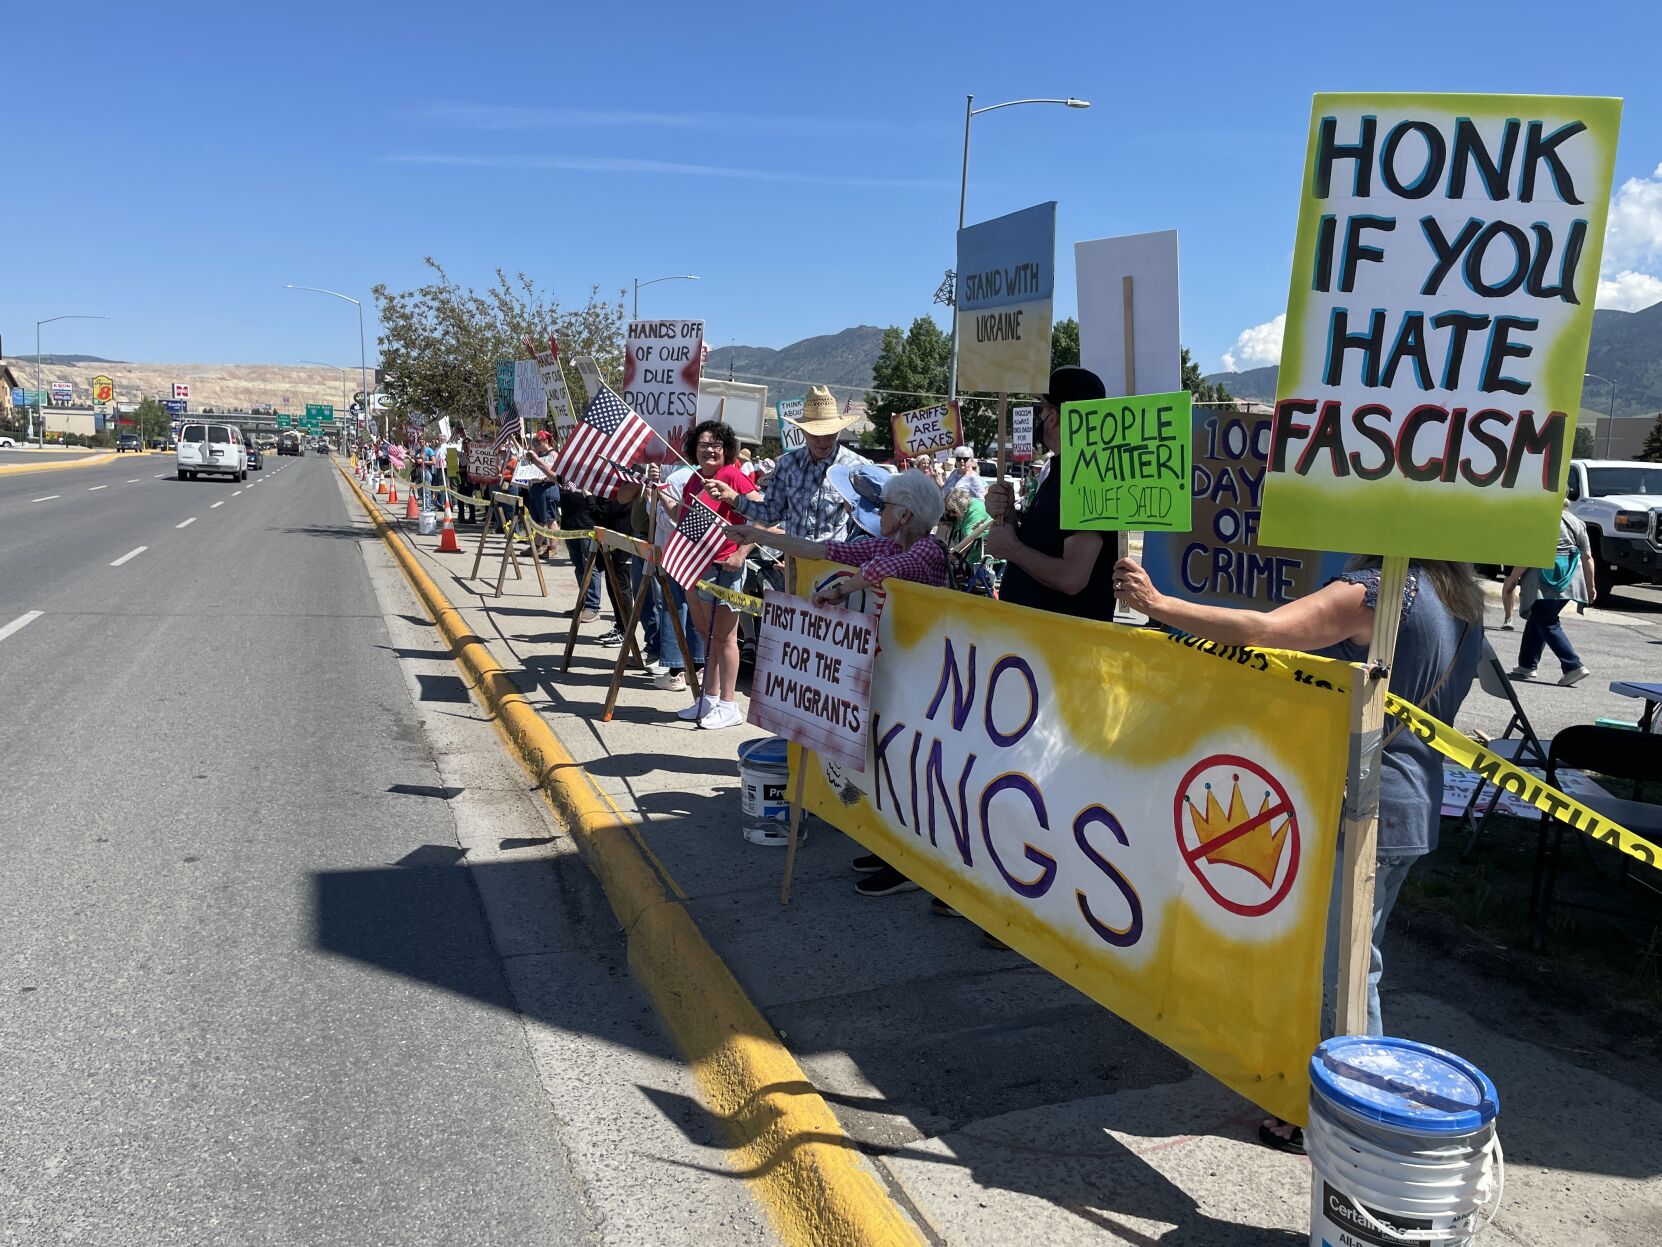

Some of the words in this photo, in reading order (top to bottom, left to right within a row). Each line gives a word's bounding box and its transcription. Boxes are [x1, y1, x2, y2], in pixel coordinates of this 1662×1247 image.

[1312, 115, 1587, 205] HONK
[1312, 214, 1396, 292] IF
[1419, 214, 1588, 305] YOU
[965, 269, 1001, 301] STAND
[1003, 262, 1040, 297] WITH
[628, 322, 676, 339] HANDS
[680, 322, 703, 339] OFF
[976, 310, 1024, 343] UKRAINE
[635, 346, 653, 362] OF
[659, 346, 690, 362] OUR
[1322, 306, 1539, 395] HATE
[97, 386, 112, 400] 8
[643, 369, 675, 385] DUE
[554, 405, 568, 417] THE
[623, 391, 697, 417] PROCESS
[783, 408, 804, 417] ABOU
[912, 419, 941, 437] ARE
[1068, 405, 1177, 447] PEOPLE
[1268, 398, 1568, 492] FASCISM
[467, 455, 497, 468] CARE
[467, 465, 498, 478] LESS
[475, 449, 498, 457] COULD
[1070, 443, 1186, 491] MATTER!
[1077, 485, 1121, 517] 'NUFF
[1127, 485, 1172, 519] SAID
[1191, 464, 1266, 507] DAY
[1212, 507, 1262, 546] OF
[1180, 542, 1303, 603] CRIME
[763, 602, 797, 632] FIRST
[800, 609, 832, 641] THEY
[832, 621, 872, 655] CAME
[781, 641, 811, 673] FOR
[815, 651, 842, 685] THE
[764, 671, 861, 734] IMMIGRANTS
[925, 636, 1039, 748] NO
[872, 711, 1144, 948] KINGS
